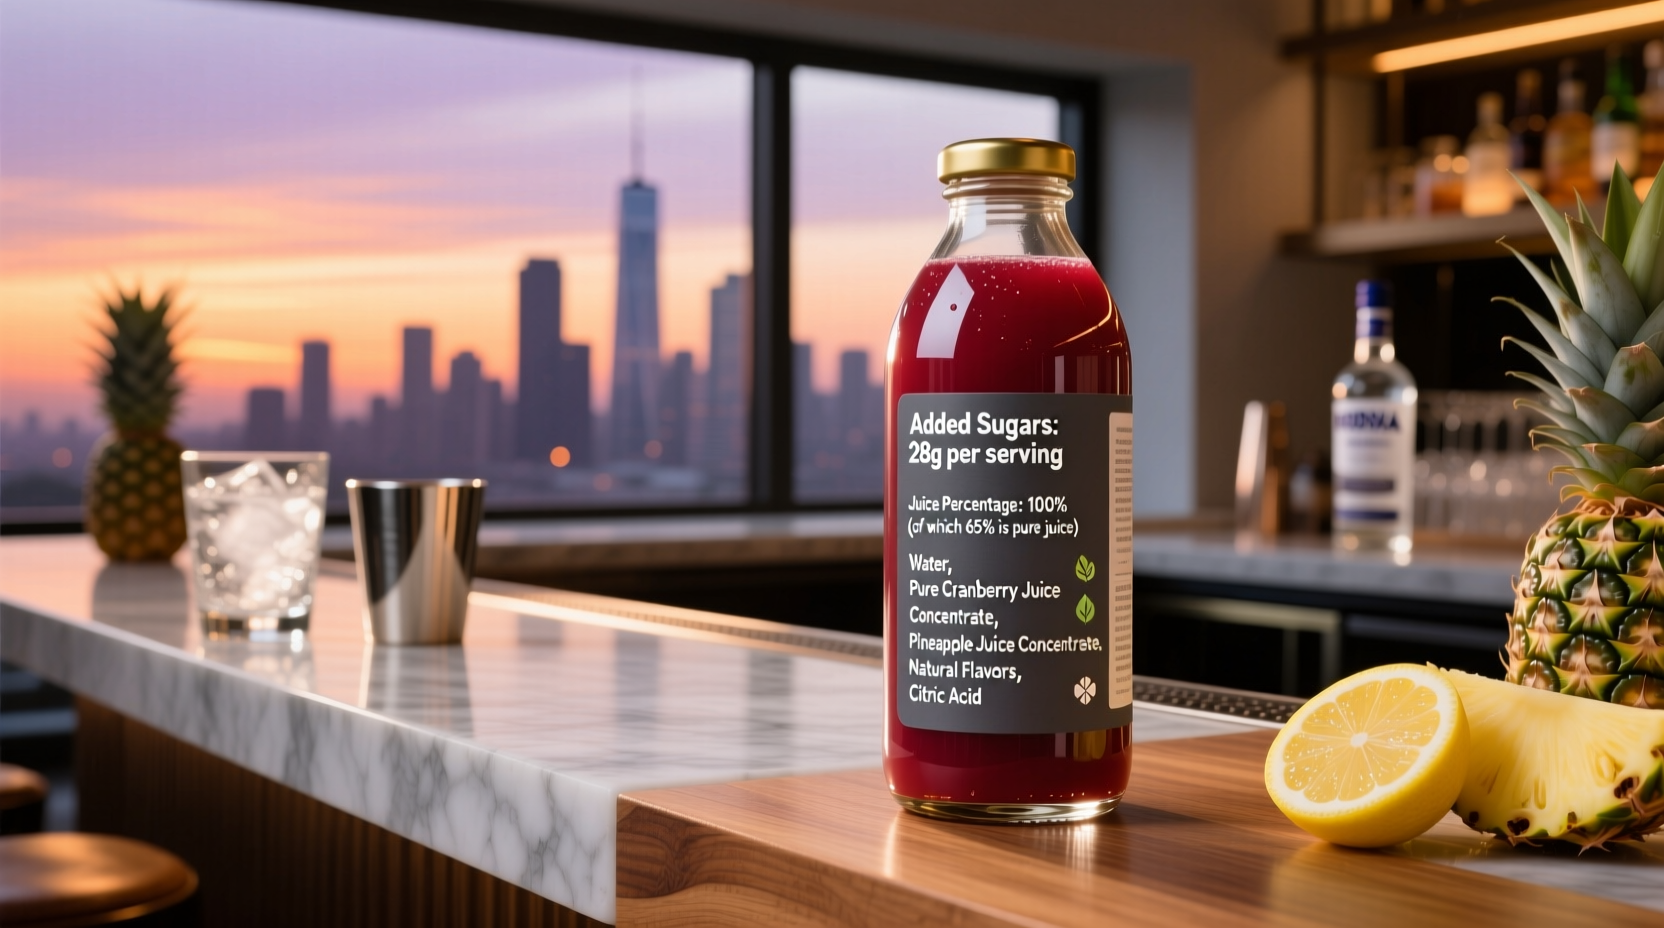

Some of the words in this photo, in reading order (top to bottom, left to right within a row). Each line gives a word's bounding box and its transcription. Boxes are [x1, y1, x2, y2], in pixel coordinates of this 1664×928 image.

[909, 411, 970, 435] Added
[977, 412, 1058, 441] Sugars:
[909, 440, 942, 470] 28g
[947, 448, 980, 470] per
[986, 442, 1062, 470] serving
[908, 495, 939, 511] Juice
[942, 496, 1022, 515] Percentage:
[1028, 496, 1067, 512] 100%
[926, 518, 962, 534] which
[966, 519, 995, 534] 65%
[998, 519, 1009, 534] is
[1013, 524, 1040, 538] pure
[1043, 518, 1078, 538] juice)
[909, 553, 952, 575] Water,
[910, 580, 939, 596] Pure
[942, 579, 1018, 602] Cranberry
[1022, 581, 1060, 598] Juice
[910, 606, 998, 629] Concentrate,
[909, 632, 973, 656] Pineapple
[976, 635, 1015, 652] Juice
[909, 658, 957, 678] Natural
[962, 661, 1021, 683] Flavors,
[909, 684, 945, 703] Citric
[949, 687, 981, 705] Acid
